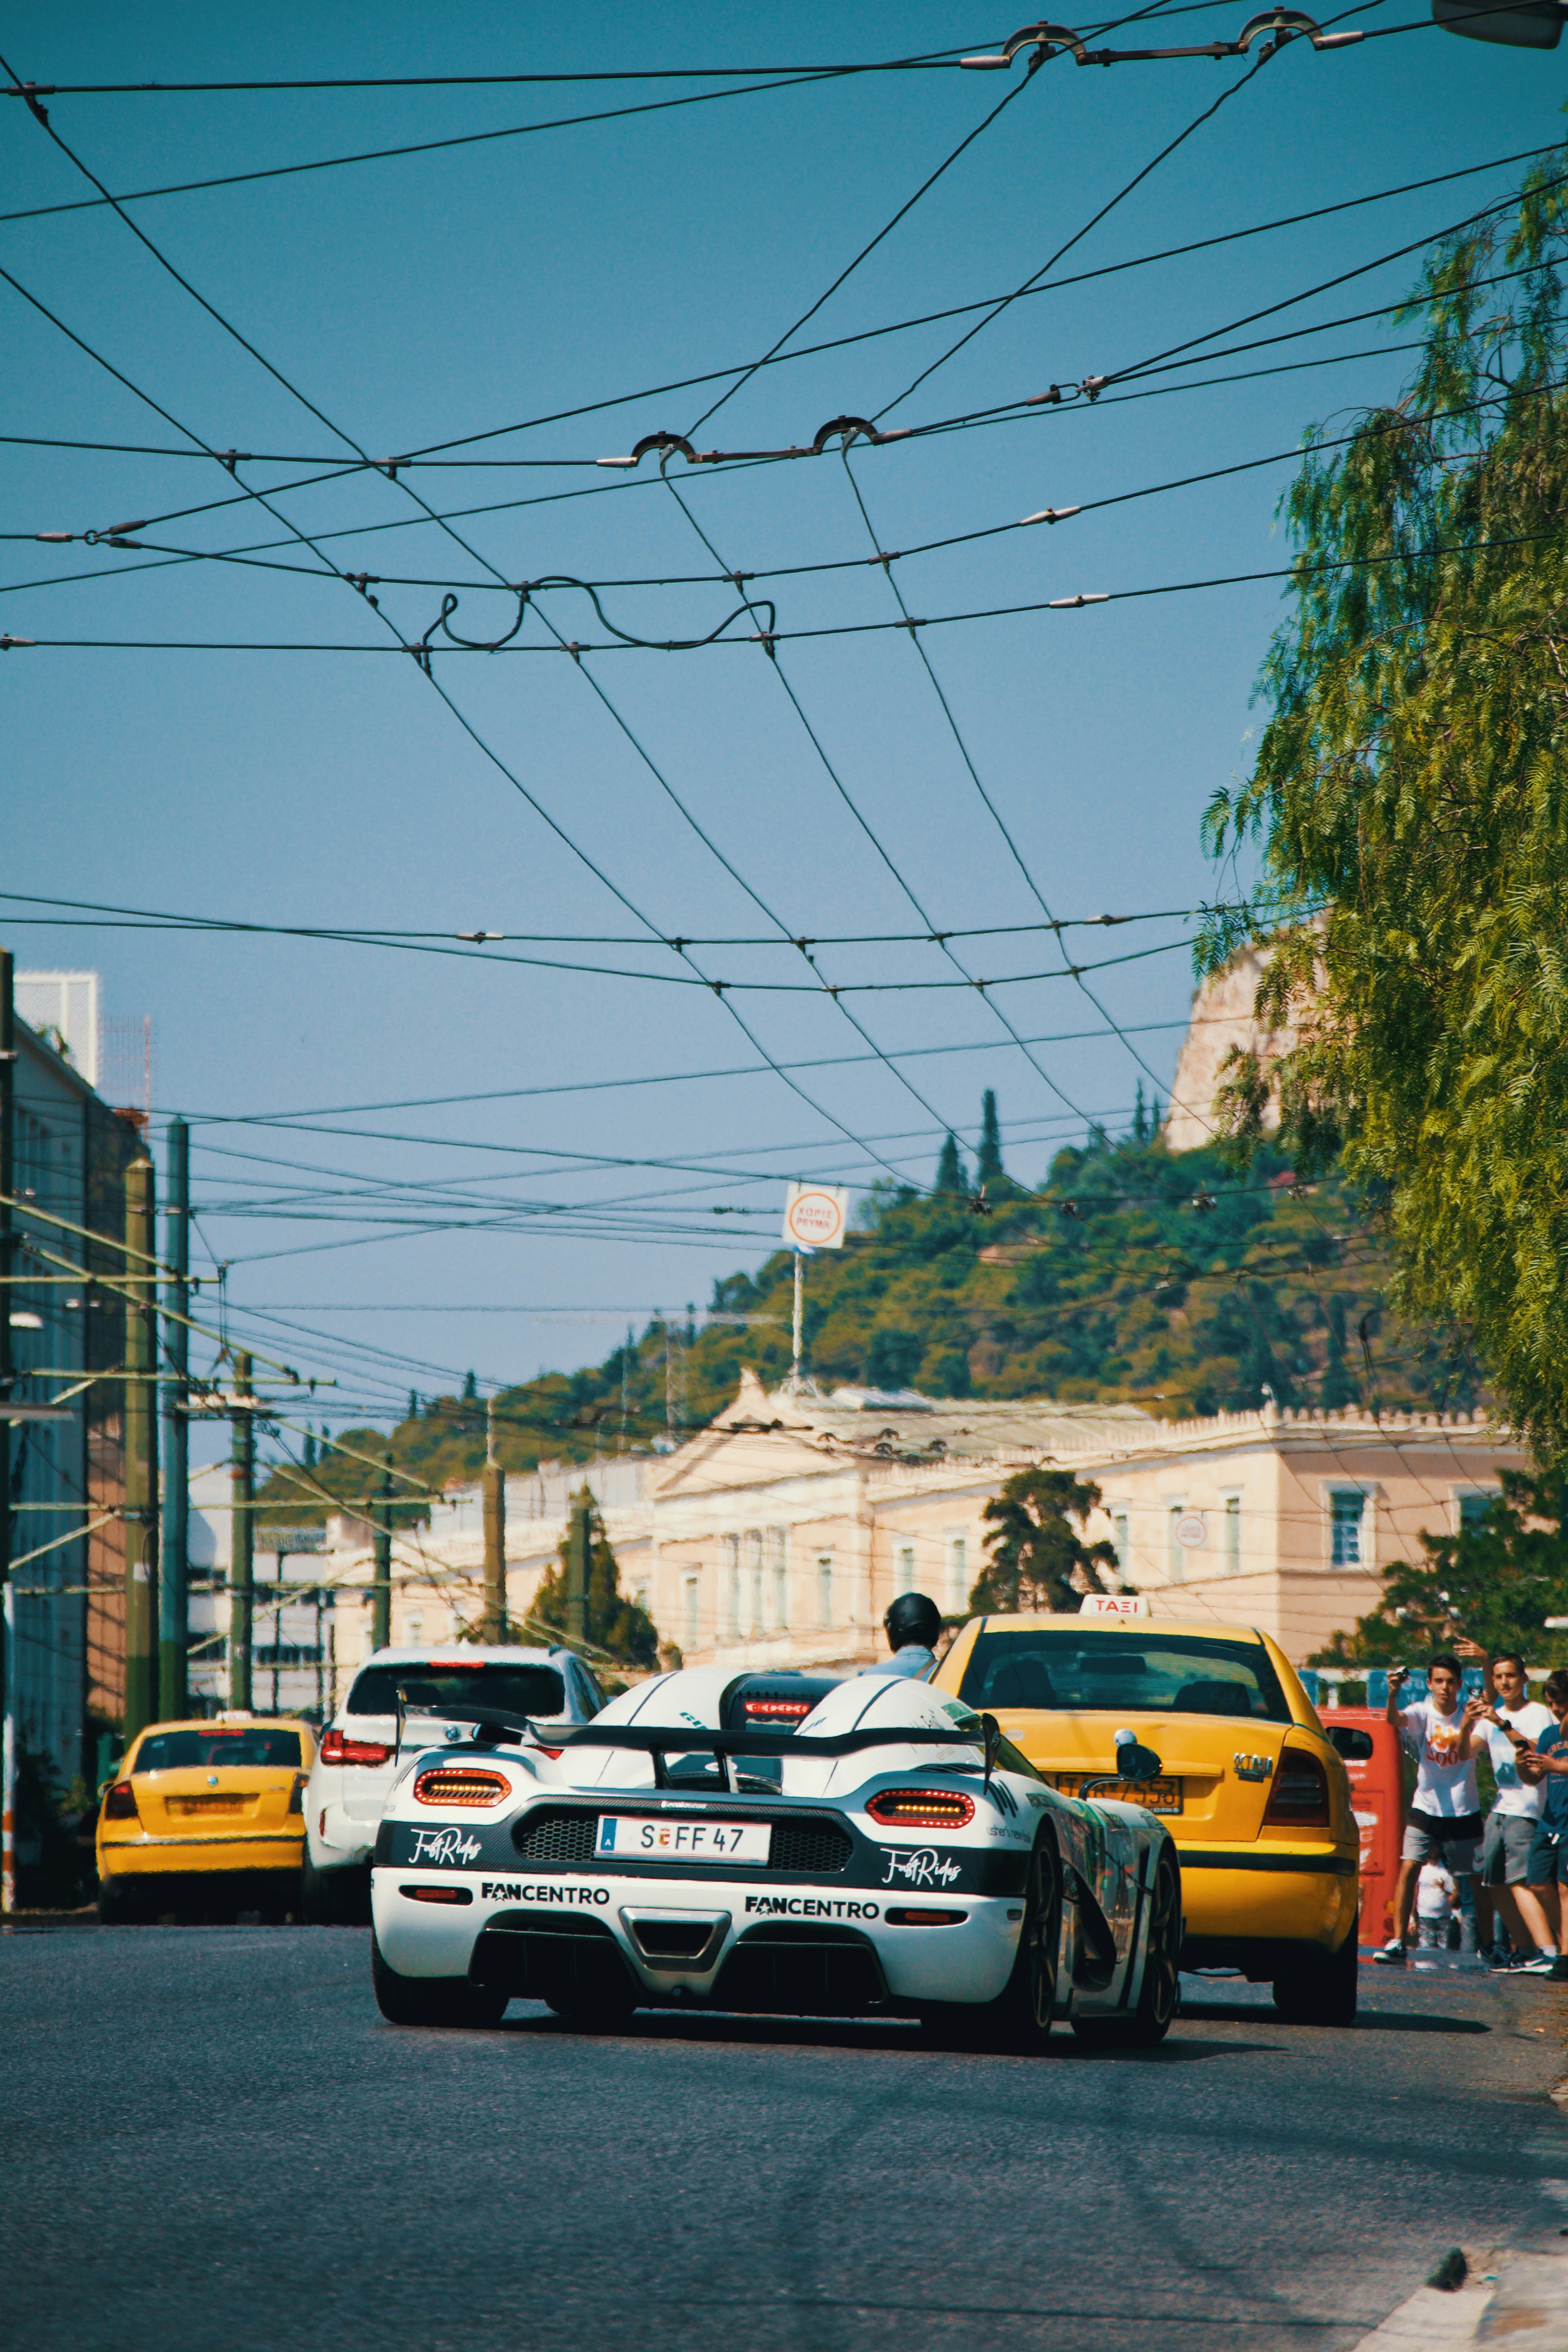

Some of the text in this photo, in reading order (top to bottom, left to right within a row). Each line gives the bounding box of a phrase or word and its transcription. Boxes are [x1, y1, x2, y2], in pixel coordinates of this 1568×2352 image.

[1096, 1600, 1138, 1613] ΤΑΞΙ
[641, 1825, 655, 1848] S
[675, 1826, 707, 1850] FF
[713, 1828, 744, 1852] 47
[481, 1882, 610, 1905] FANCENTRO
[745, 1896, 880, 1919] FANCENTRO
